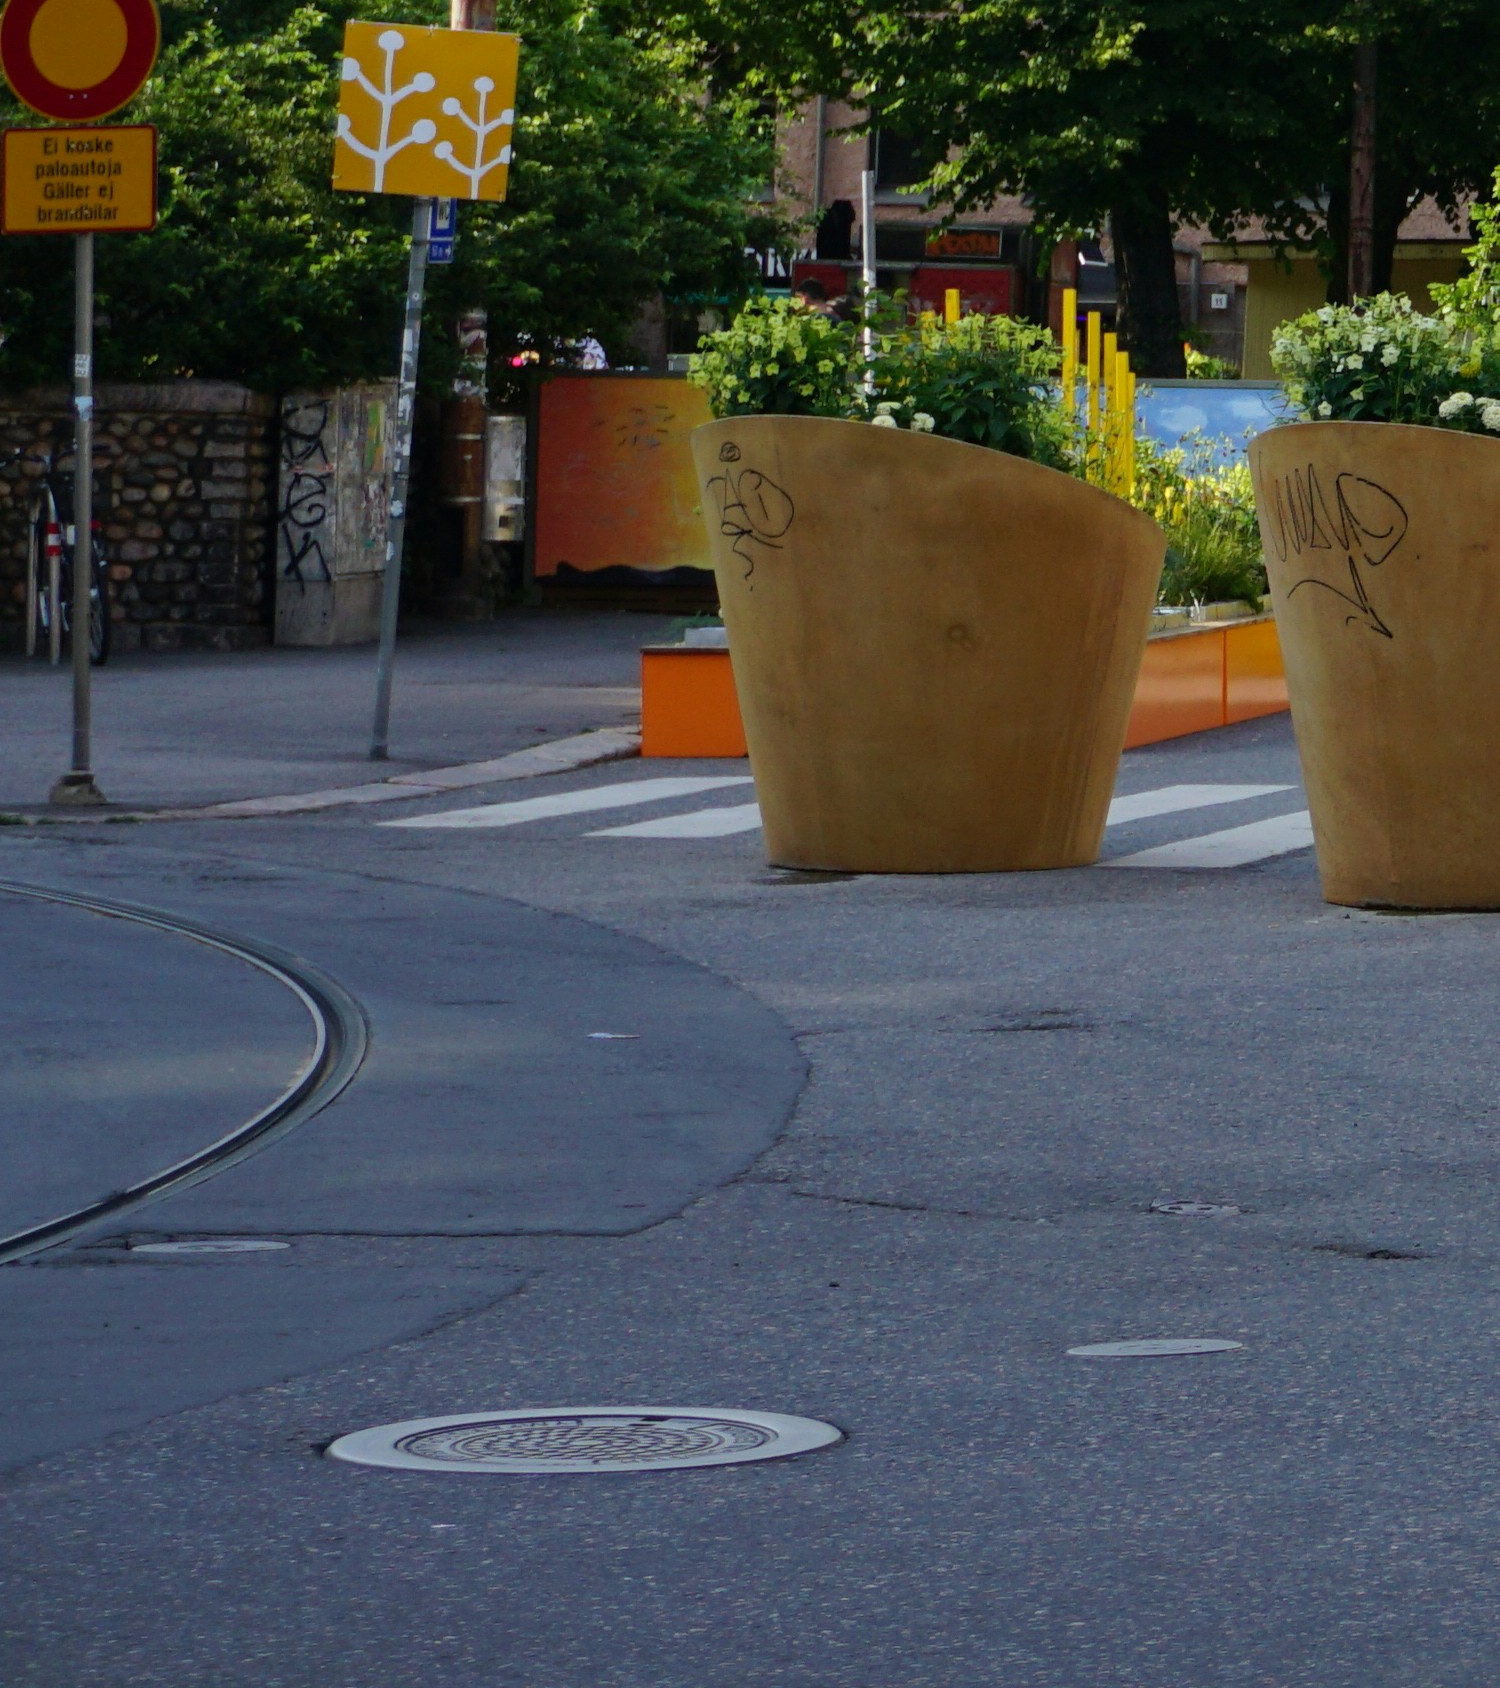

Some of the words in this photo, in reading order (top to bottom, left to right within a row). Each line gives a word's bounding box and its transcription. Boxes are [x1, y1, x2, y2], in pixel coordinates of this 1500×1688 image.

[44, 137, 58, 154] Ei
[65, 136, 113, 153] koske
[35, 158, 122, 180] paloautoja
[43, 181, 90, 199] Gäller
[99, 180, 114, 200] ej
[37, 204, 118, 223] brandbilar
